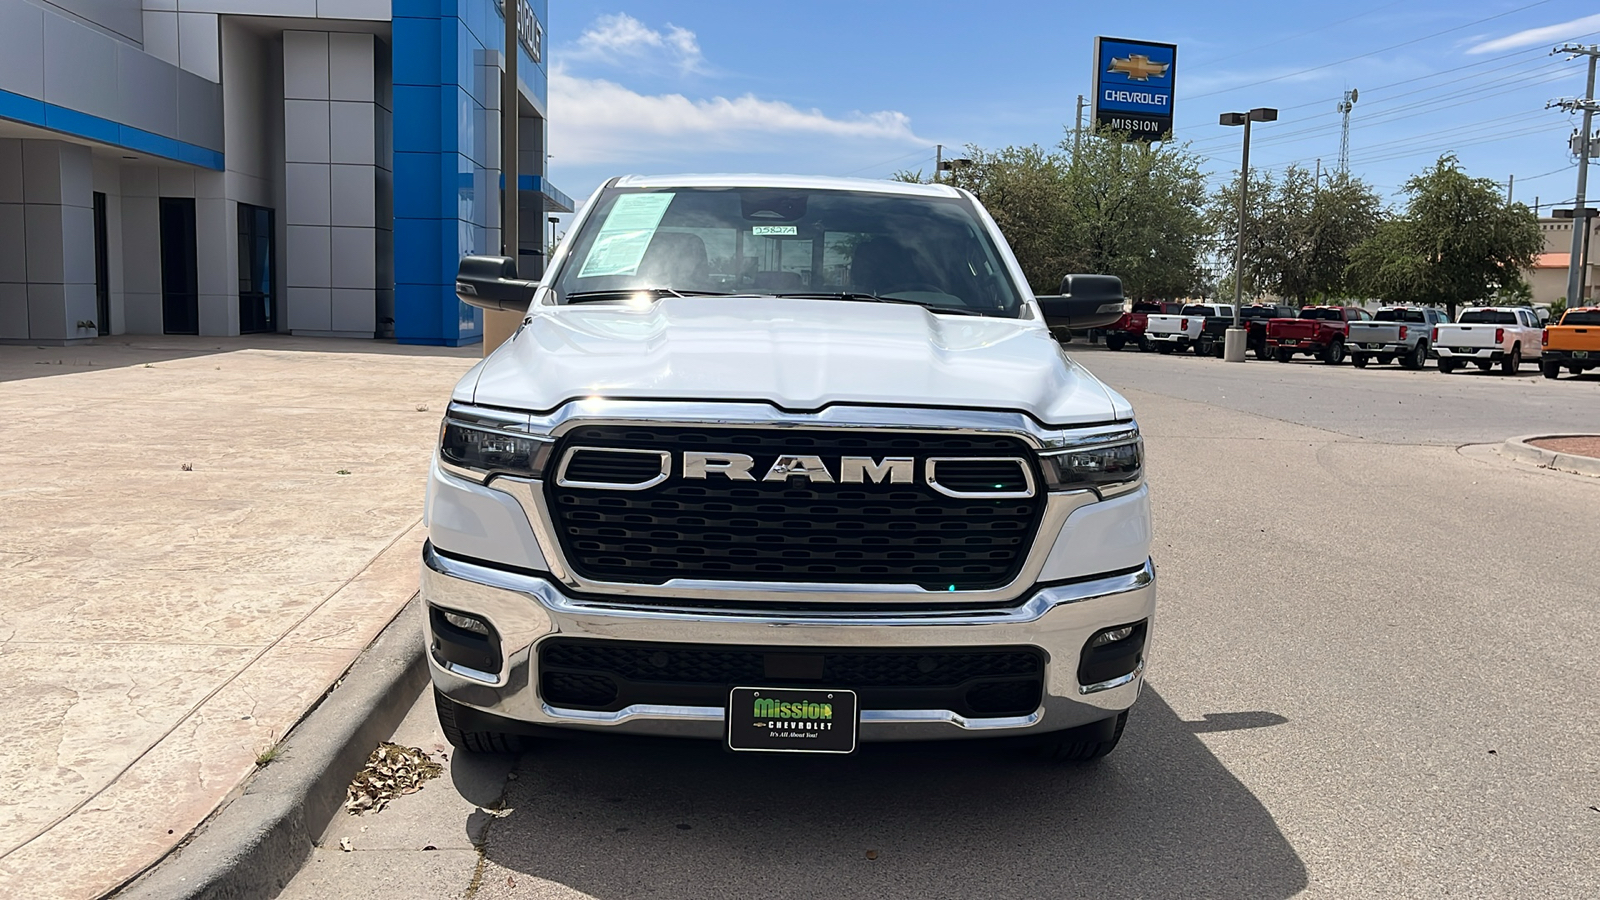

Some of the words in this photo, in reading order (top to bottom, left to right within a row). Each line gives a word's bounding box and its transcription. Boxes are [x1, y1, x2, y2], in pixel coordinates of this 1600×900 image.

[1105, 90, 1168, 105] CHEVROLET
[1112, 118, 1158, 131] MISSION
[682, 451, 915, 484] RAM
[754, 698, 832, 719] Mission
[768, 721, 833, 730] CHEVROLET
